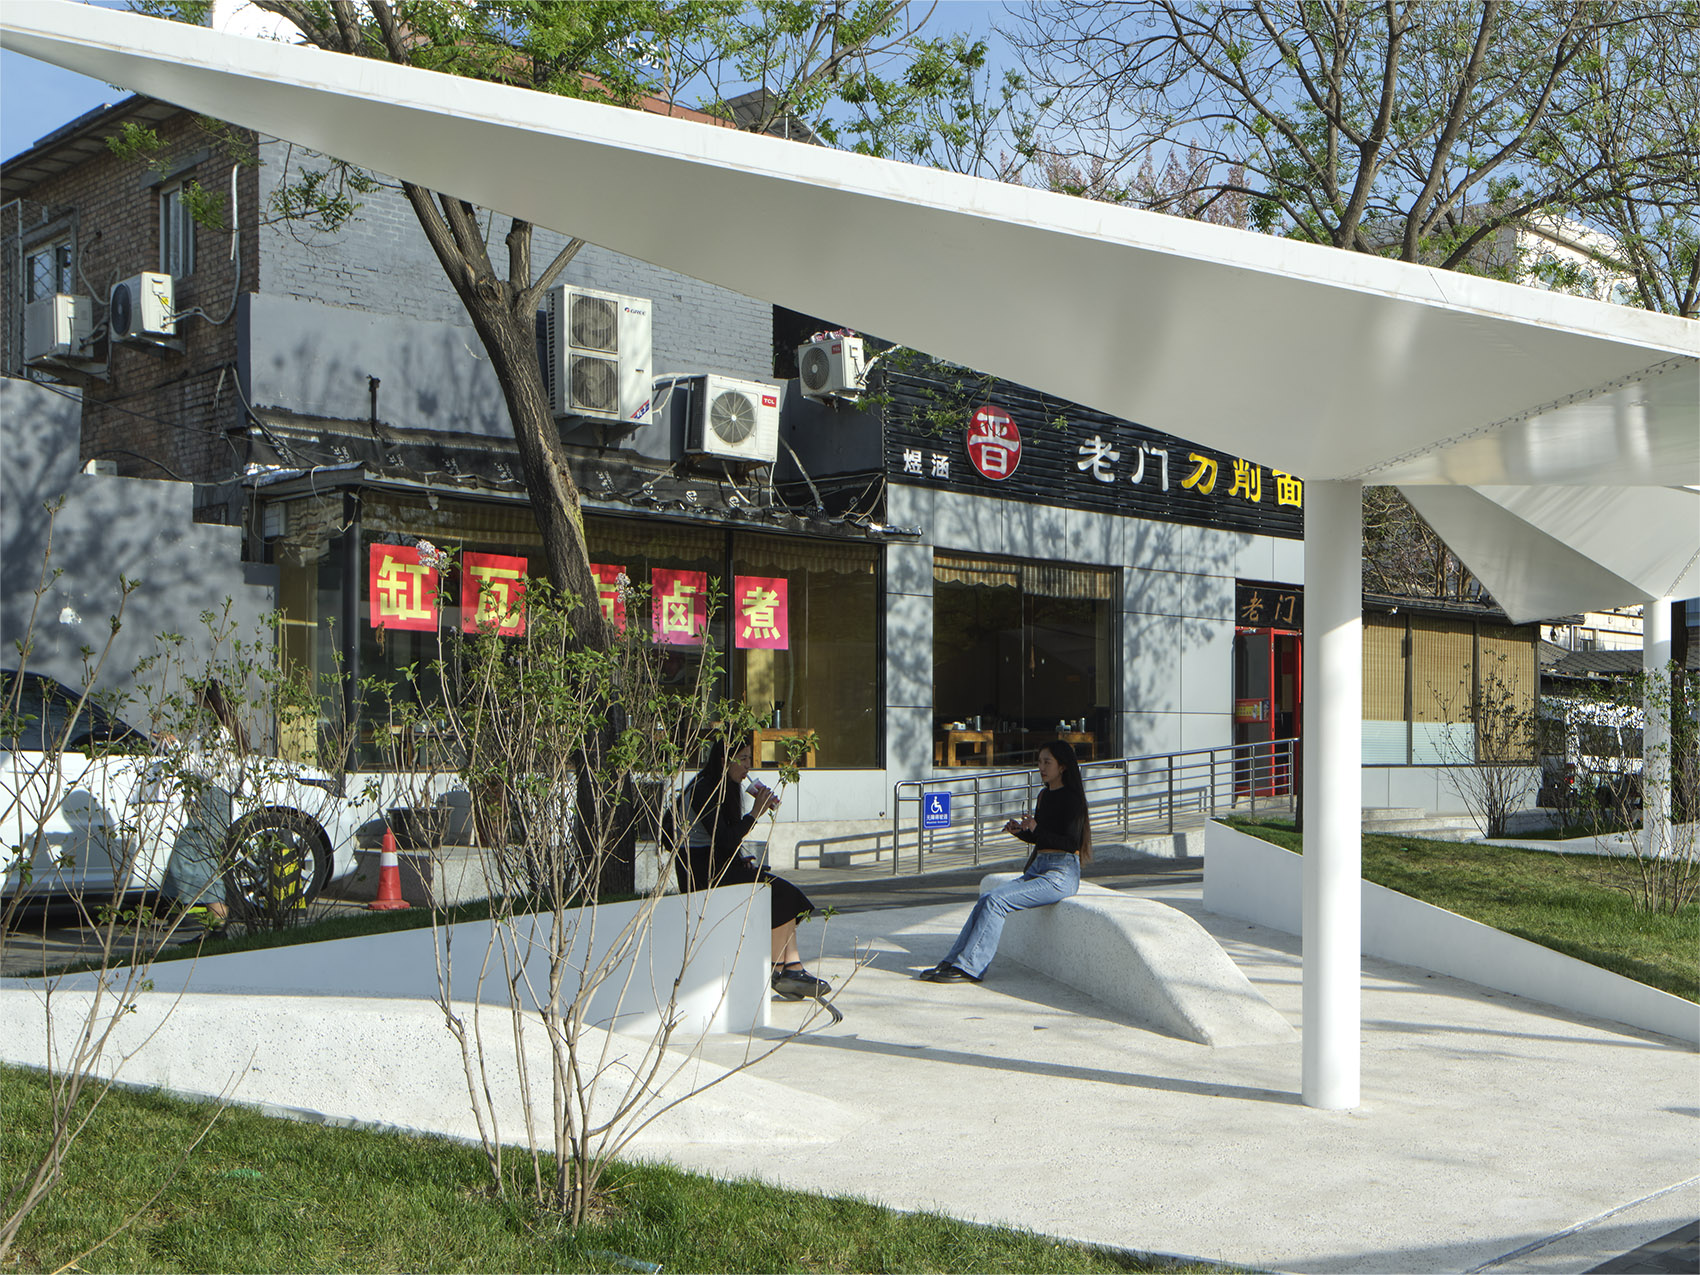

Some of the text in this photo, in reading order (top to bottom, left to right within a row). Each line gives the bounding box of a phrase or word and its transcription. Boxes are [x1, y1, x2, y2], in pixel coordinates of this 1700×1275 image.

[764, 397, 775, 405] TCL
[969, 412, 1019, 475] 晋
[903, 448, 950, 478] 煜涵
[1077, 434, 1304, 508] 老门刀削面
[1241, 591, 1296, 624] 老门
